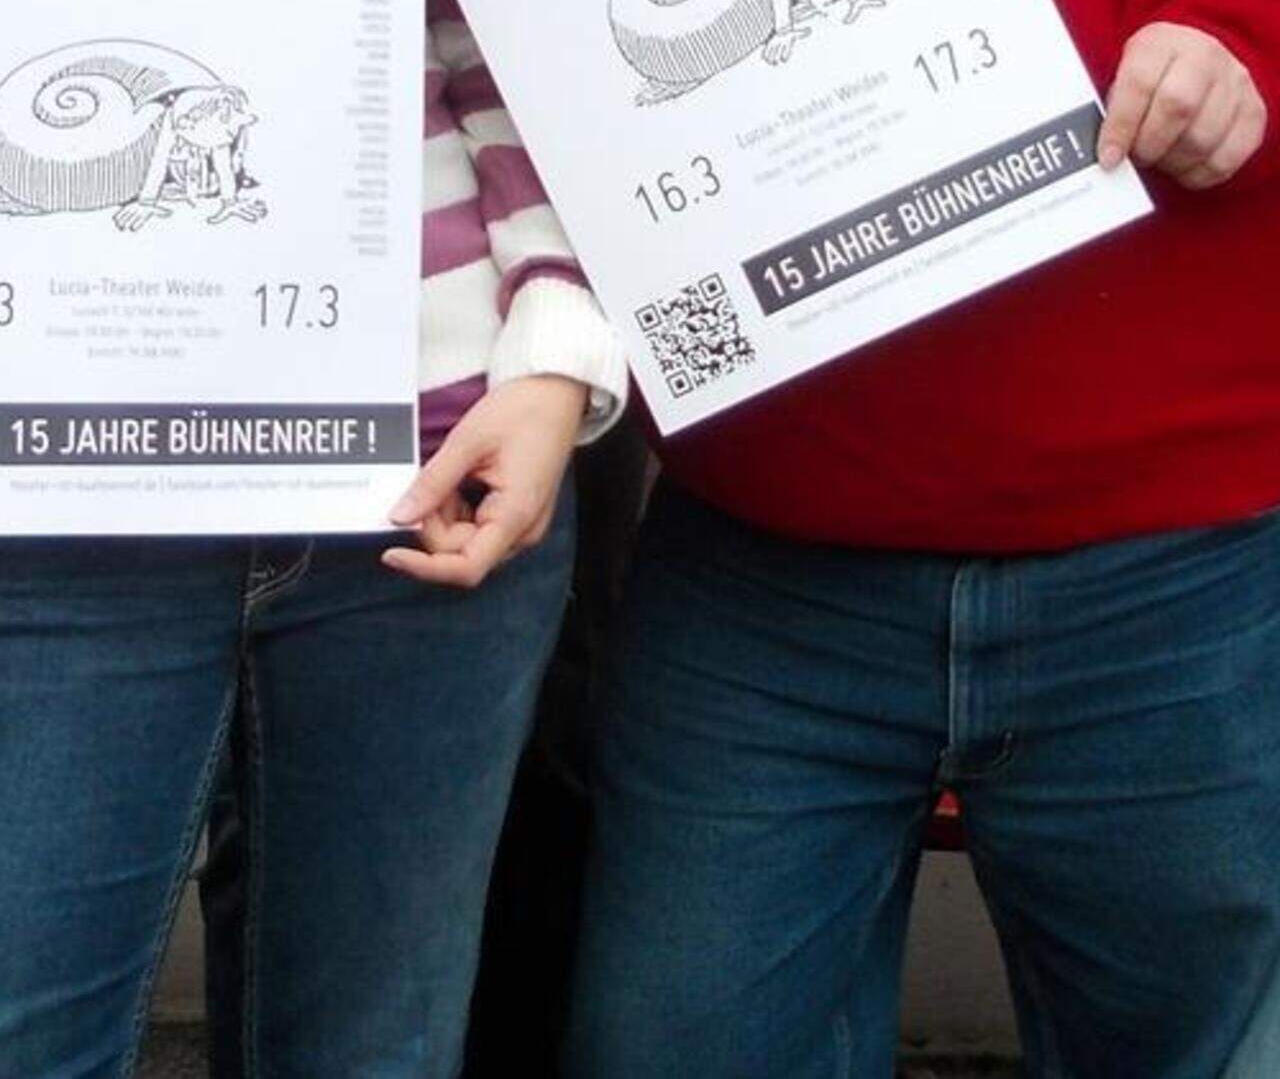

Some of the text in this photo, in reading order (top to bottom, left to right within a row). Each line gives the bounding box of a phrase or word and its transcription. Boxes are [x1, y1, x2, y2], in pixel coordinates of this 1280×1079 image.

[913, 27, 999, 94] 17.3
[635, 155, 722, 225] 16.3
[762, 257, 805, 301] 15
[811, 213, 901, 281] JAHRE
[898, 137, 1065, 239] BÜHNENREIF
[253, 283, 340, 329] 17.3
[11, 420, 49, 456] 15
[61, 420, 158, 456] JAHRE
[169, 409, 359, 456] BÜHNENREIF
